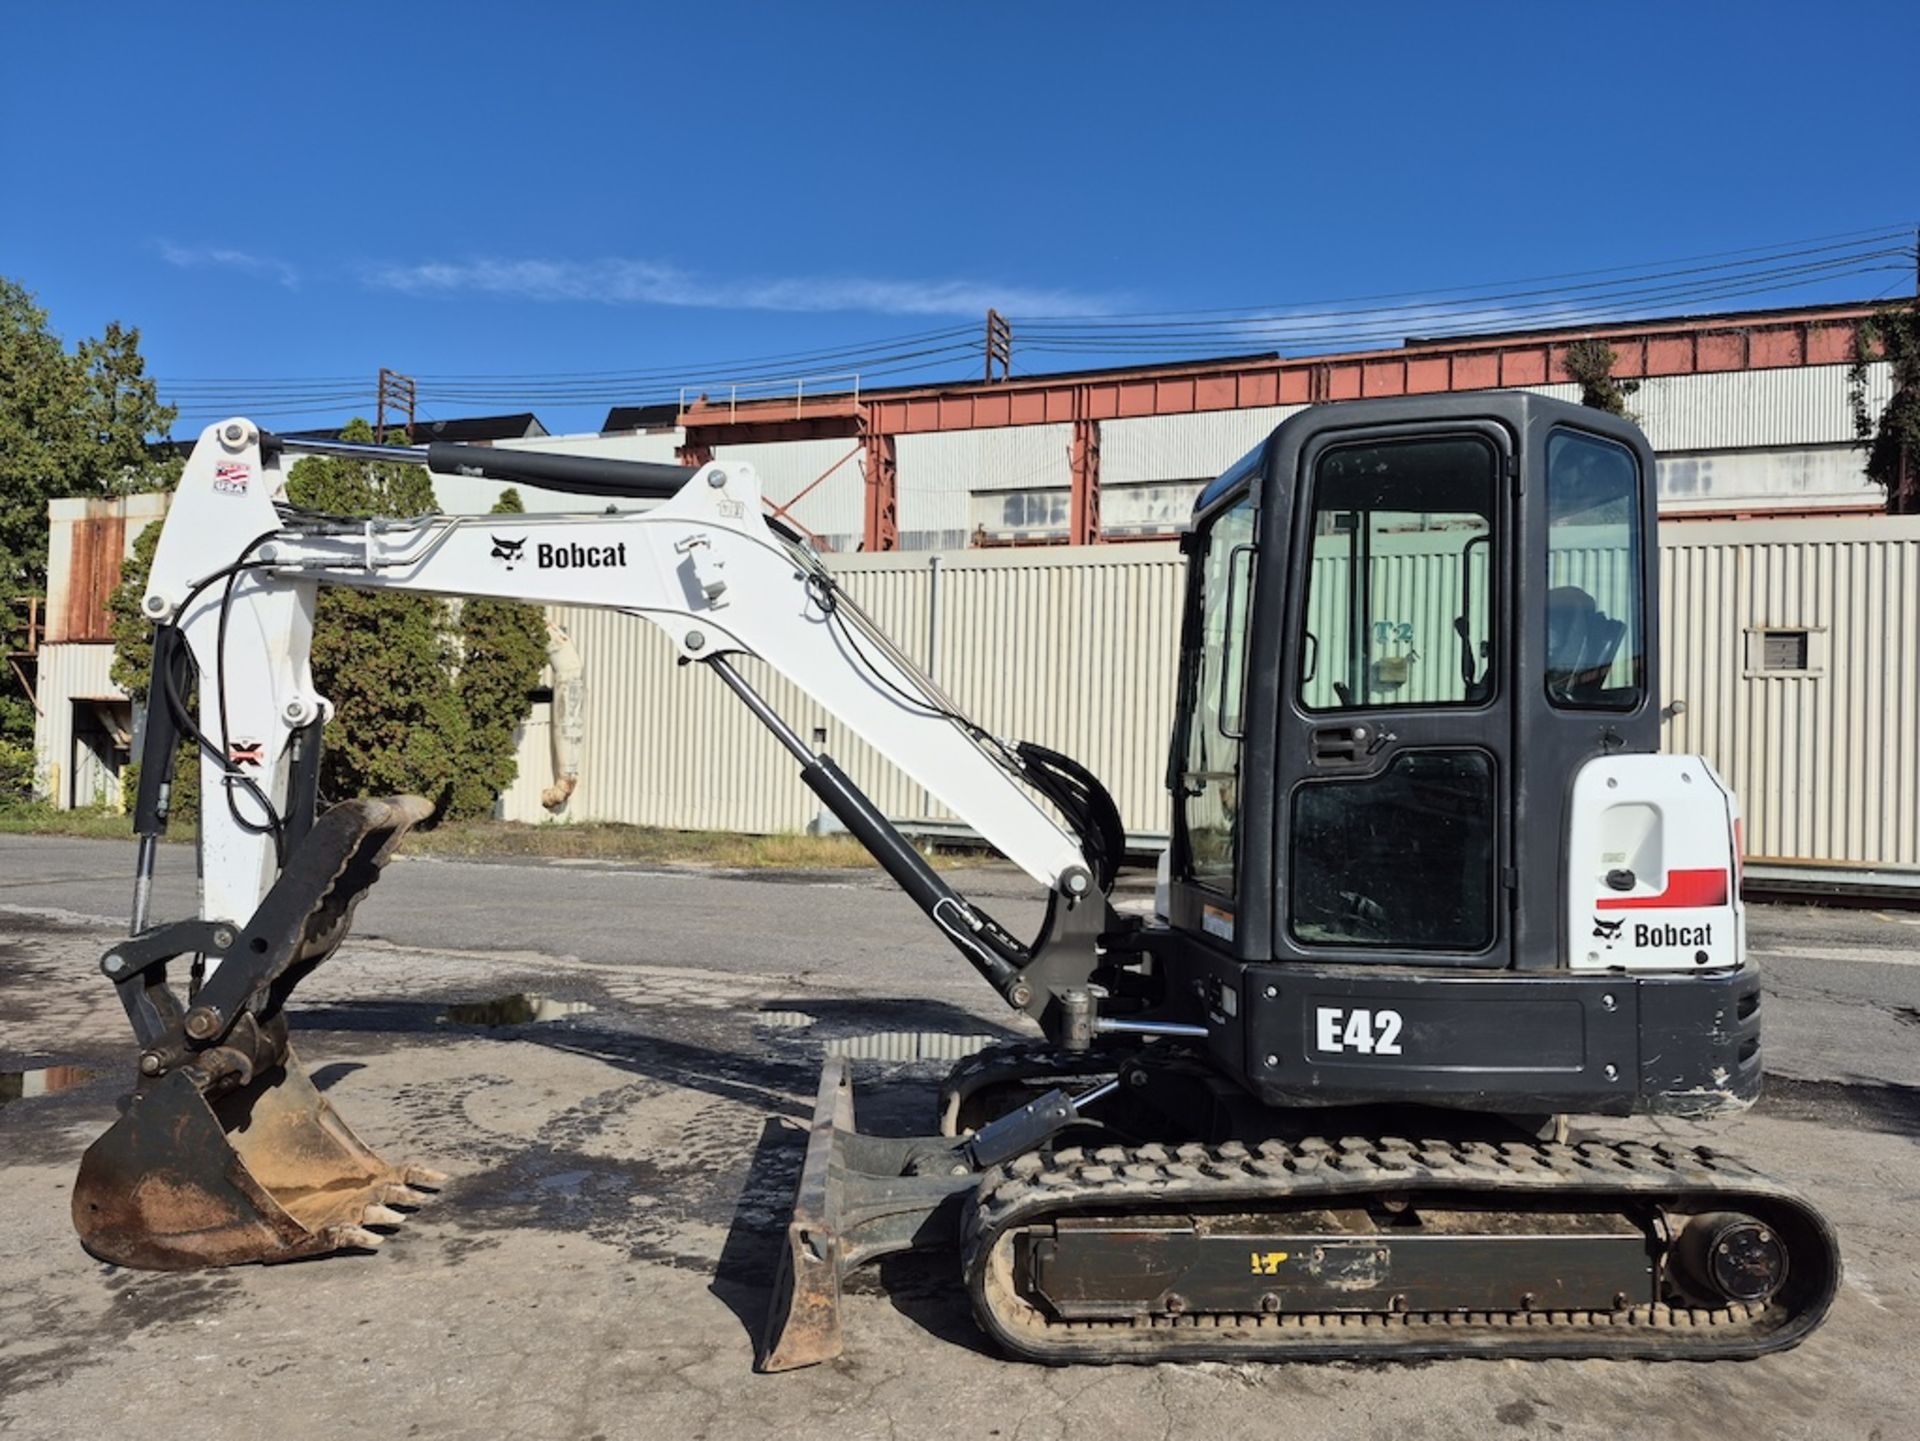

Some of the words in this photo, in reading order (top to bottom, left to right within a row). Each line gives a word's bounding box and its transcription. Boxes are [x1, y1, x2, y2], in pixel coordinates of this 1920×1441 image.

[538, 542, 626, 568] Bobcat
[1374, 621, 1413, 641] T2
[1635, 923, 1712, 947] Bobcat
[1316, 1007, 1402, 1055] E42
